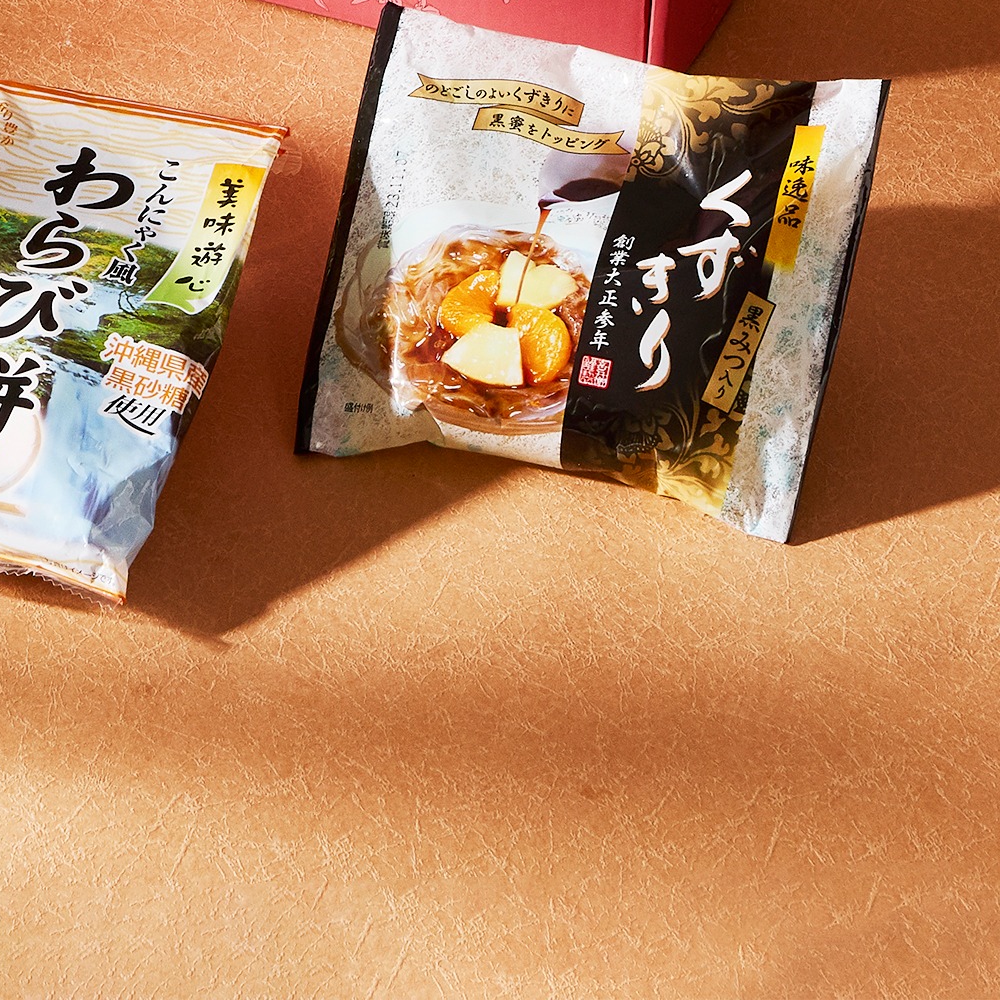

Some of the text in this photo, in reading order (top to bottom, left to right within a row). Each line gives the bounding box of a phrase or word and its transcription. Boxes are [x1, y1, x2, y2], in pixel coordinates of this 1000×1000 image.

[424, 83, 575, 118] のどごしのよいくずきりに
[488, 113, 611, 150] 黒蜜をトッピング
[103, 159, 180, 285] こんにゃく風
[174, 177, 245, 292] 美味遊心
[589, 233, 636, 351] 創業大正参年
[104, 336, 208, 400] 沖縄県産
[714, 305, 764, 399] 黒みつ入り
[103, 394, 167, 436] 使用
[104, 365, 190, 412] 黒砂糖
